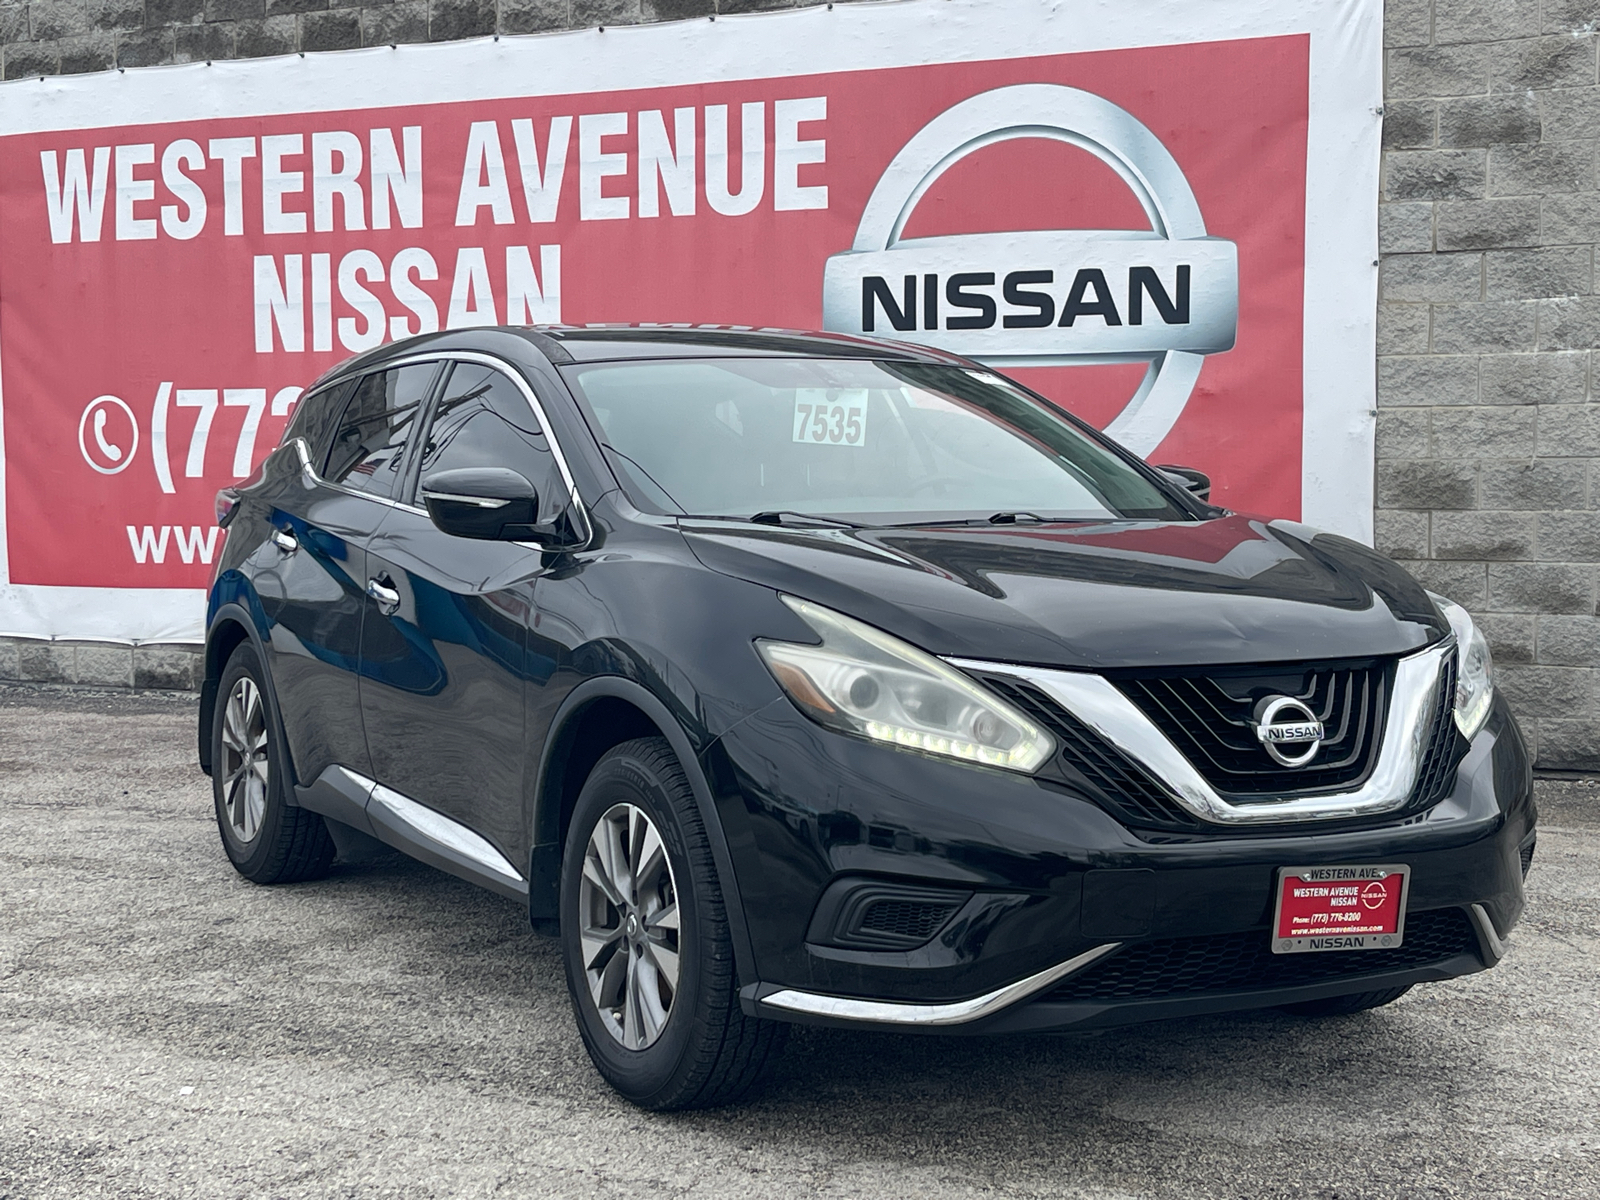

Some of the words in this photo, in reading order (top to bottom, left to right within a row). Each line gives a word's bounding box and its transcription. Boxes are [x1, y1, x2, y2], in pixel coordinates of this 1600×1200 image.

[41, 126, 423, 244] WESTERN
[455, 97, 829, 226] AVENUE
[254, 244, 561, 352] NISSAN
[862, 264, 1191, 331] NISSAN
[797, 403, 861, 444] 7535
[1268, 726, 1322, 739] NISSAN
[1310, 868, 1356, 880] WESTERN
[1293, 887, 1329, 898] WESTERN
[1329, 886, 1359, 897] AVENUE
[1330, 897, 1357, 906] NISSAN
[1310, 912, 1328, 924] (773)
[1310, 937, 1364, 948] NISSAN
